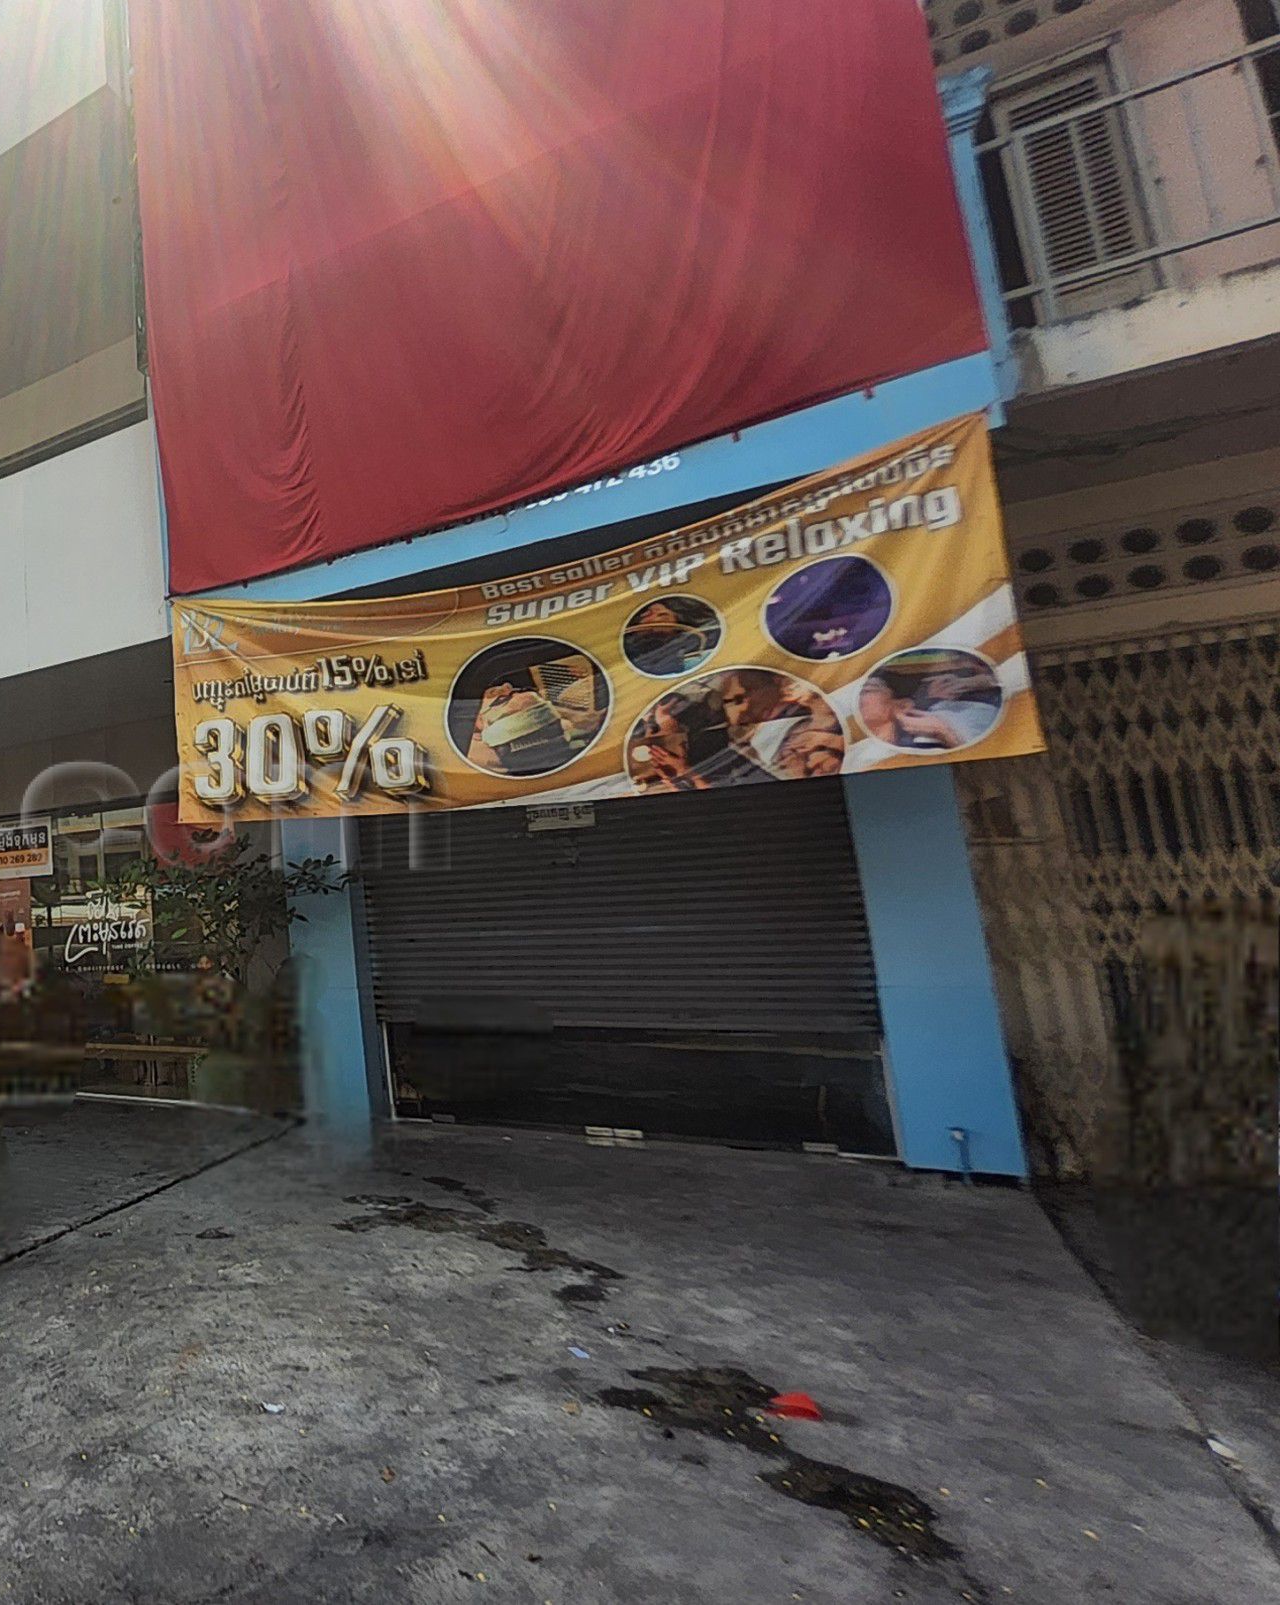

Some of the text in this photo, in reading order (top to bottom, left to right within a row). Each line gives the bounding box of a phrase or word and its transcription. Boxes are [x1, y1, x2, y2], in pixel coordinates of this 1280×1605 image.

[480, 575, 545, 601] Best
[485, 485, 961, 627] Super VIP Relaxing
[193, 703, 426, 804] 30%
